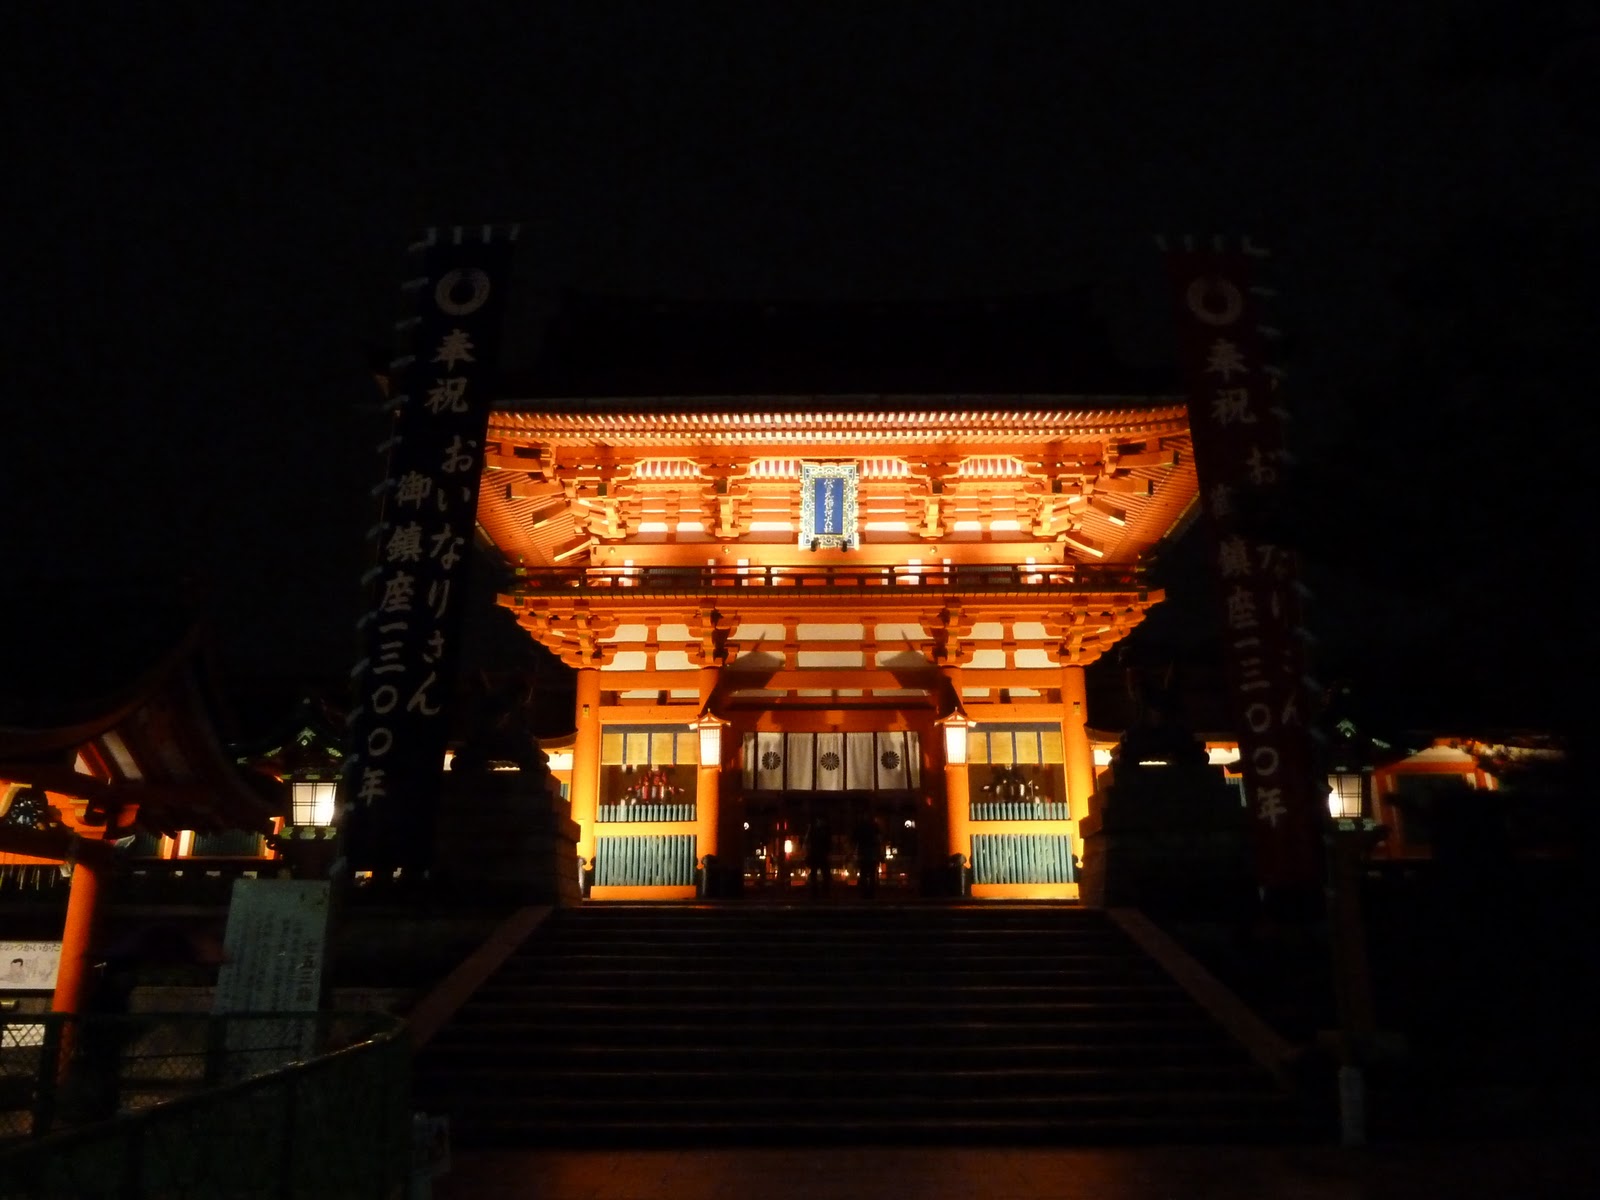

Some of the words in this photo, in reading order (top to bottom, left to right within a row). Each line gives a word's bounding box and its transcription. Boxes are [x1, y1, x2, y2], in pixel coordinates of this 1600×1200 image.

[423, 327, 478, 416] 奉祝
[1202, 336, 1259, 427] 奉祝
[405, 433, 478, 717] おいなりさん
